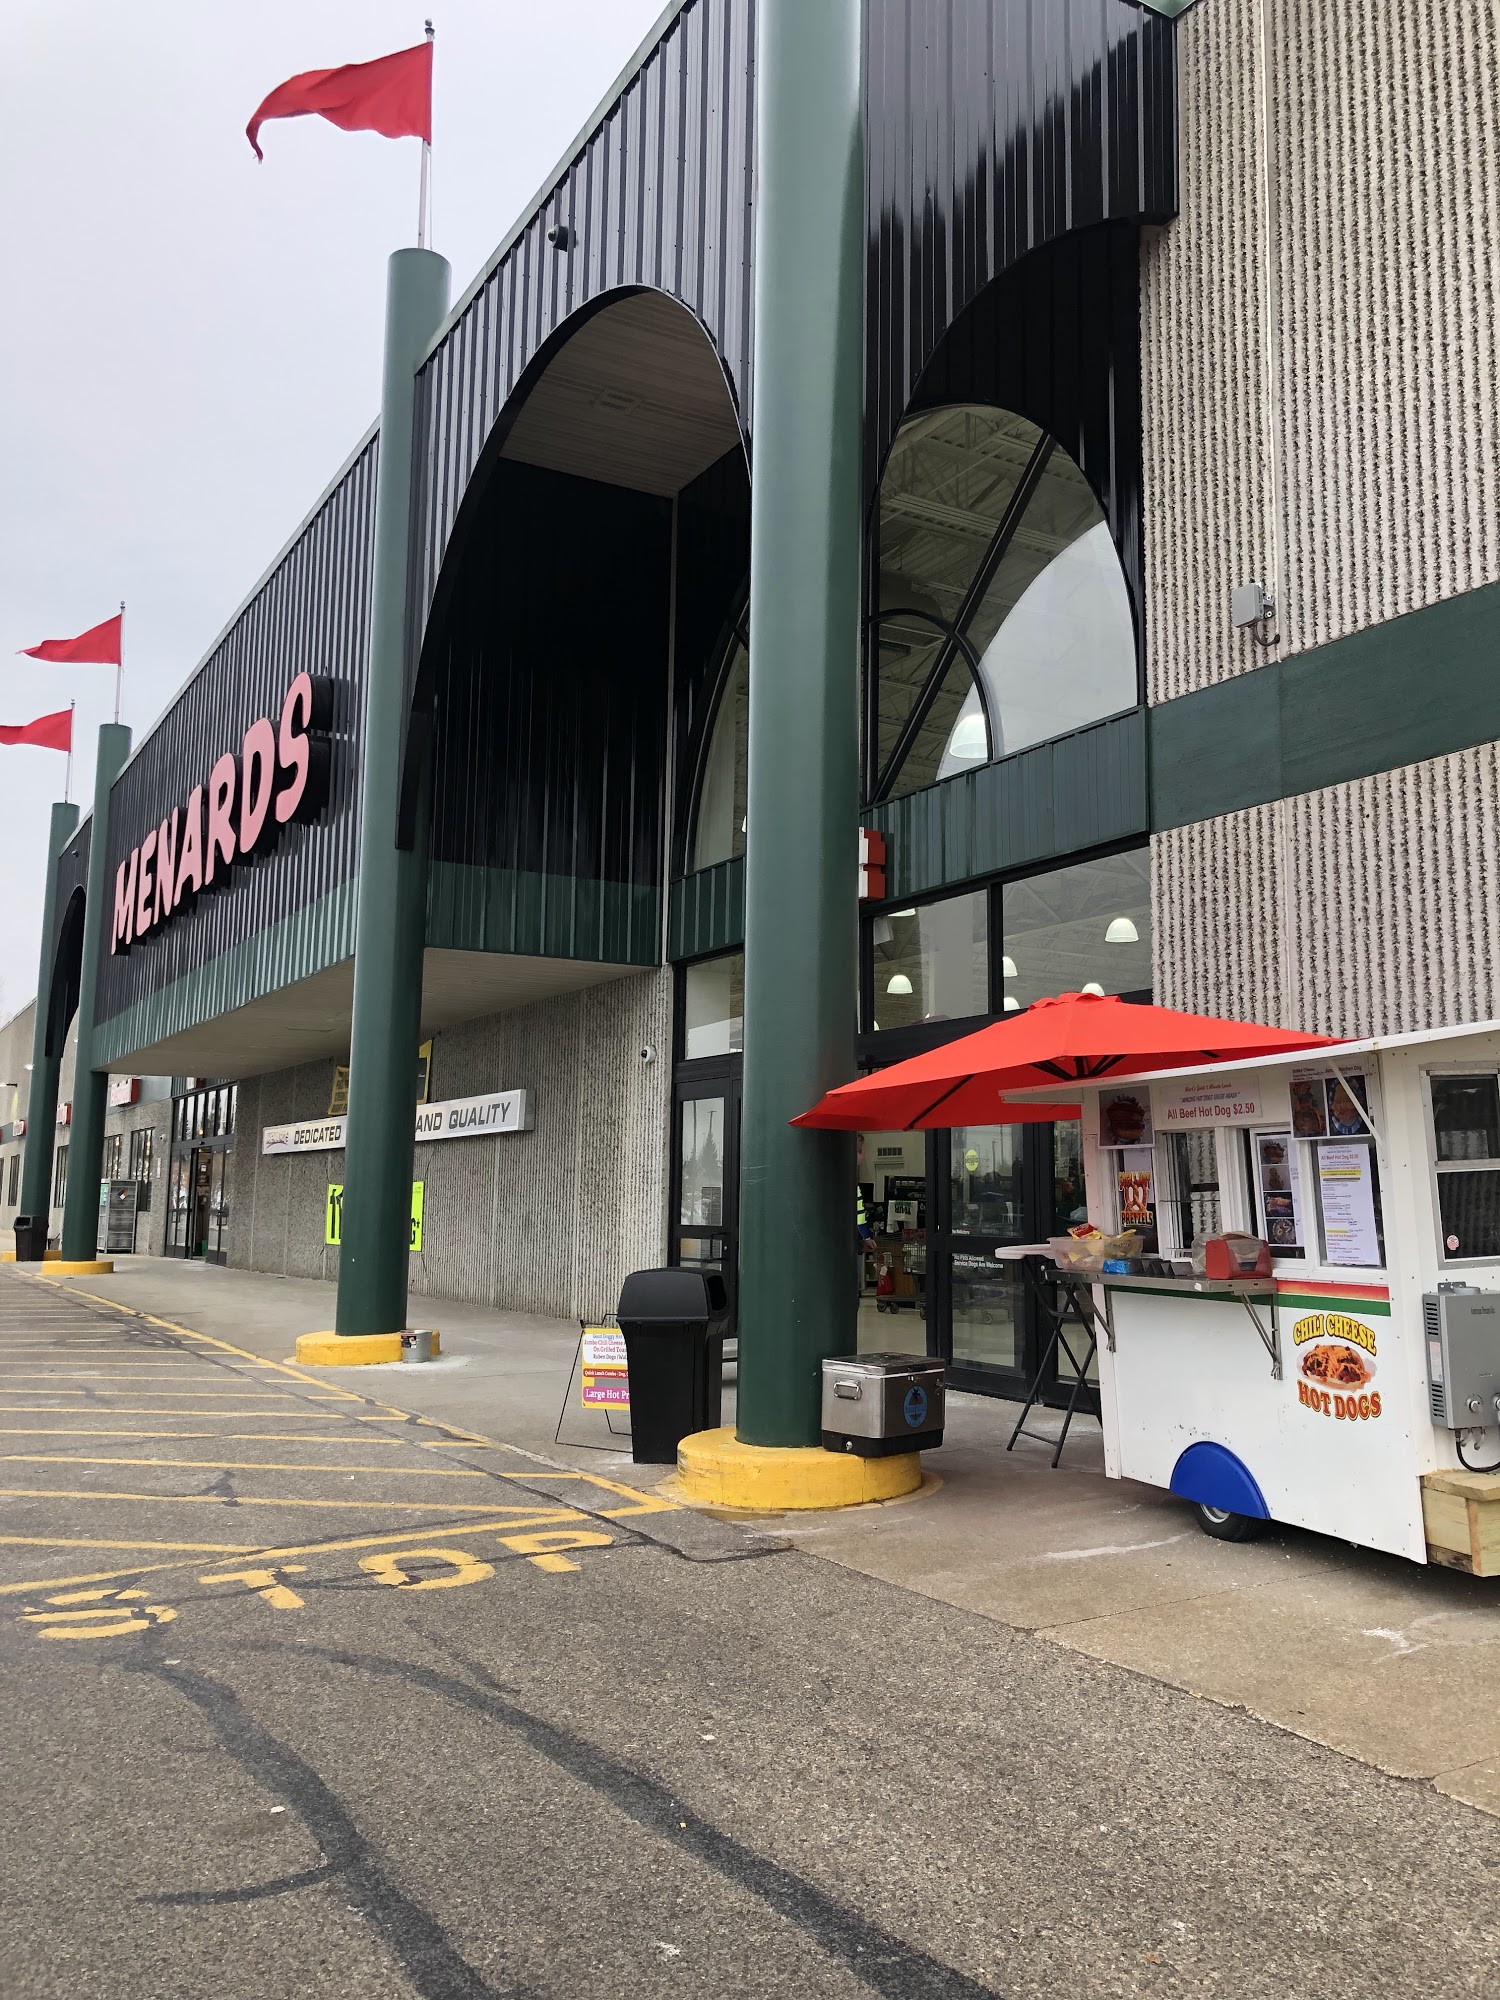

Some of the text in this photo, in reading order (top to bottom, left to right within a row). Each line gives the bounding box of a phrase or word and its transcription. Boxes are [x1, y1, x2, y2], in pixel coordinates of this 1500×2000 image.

[111, 672, 312, 955] MENARDS
[294, 1125, 342, 1145] DEDICATED
[415, 1112, 443, 1132] AND
[448, 1101, 512, 1130] QUALITY
[1167, 1102, 1255, 1120] All Beef Hot Dog $2.50
[1121, 1211, 1153, 1226] PRETZELS
[1293, 1313, 1377, 1356] CHILI CHEESE
[586, 1388, 606, 1401] Large
[607, 1390, 620, 1399] Hot
[1297, 1379, 1382, 1421] HOT DOGS
[15, 1530, 615, 1640] STOP
